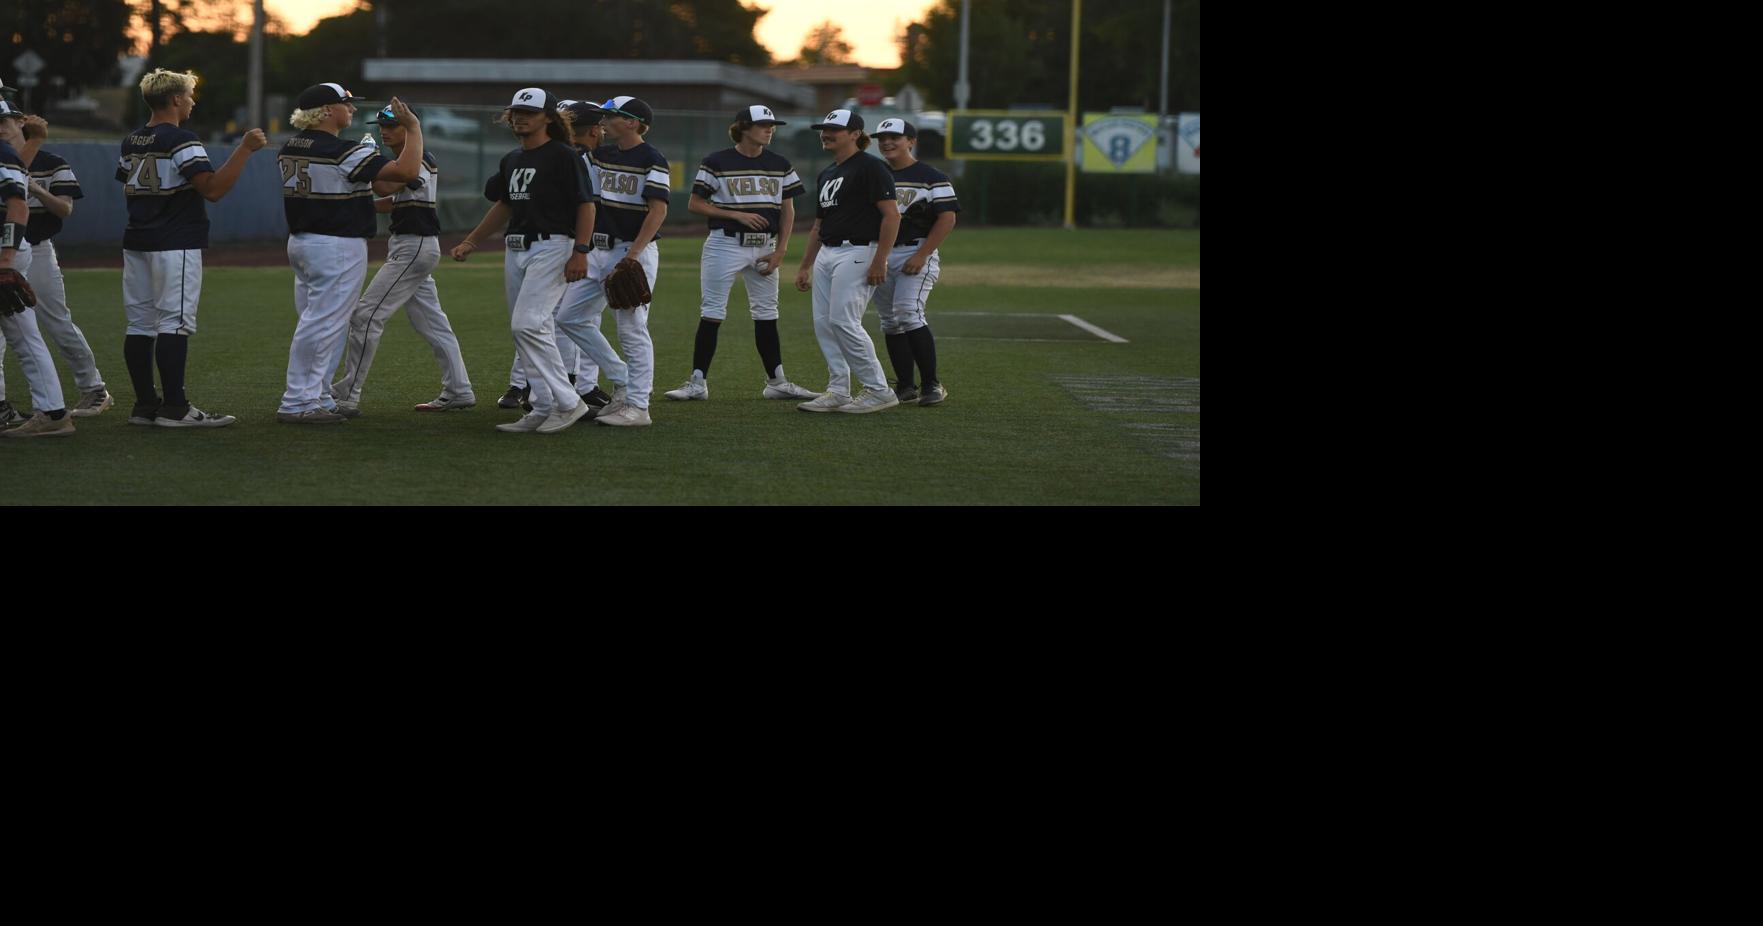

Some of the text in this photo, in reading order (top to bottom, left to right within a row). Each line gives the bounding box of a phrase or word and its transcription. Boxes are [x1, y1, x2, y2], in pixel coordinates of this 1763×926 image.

[969, 119, 1045, 151] 336
[123, 153, 161, 195] 24
[281, 158, 311, 196] 25
[509, 168, 536, 193] KP
[726, 177, 780, 197] KELSO
[820, 177, 844, 202] KP
